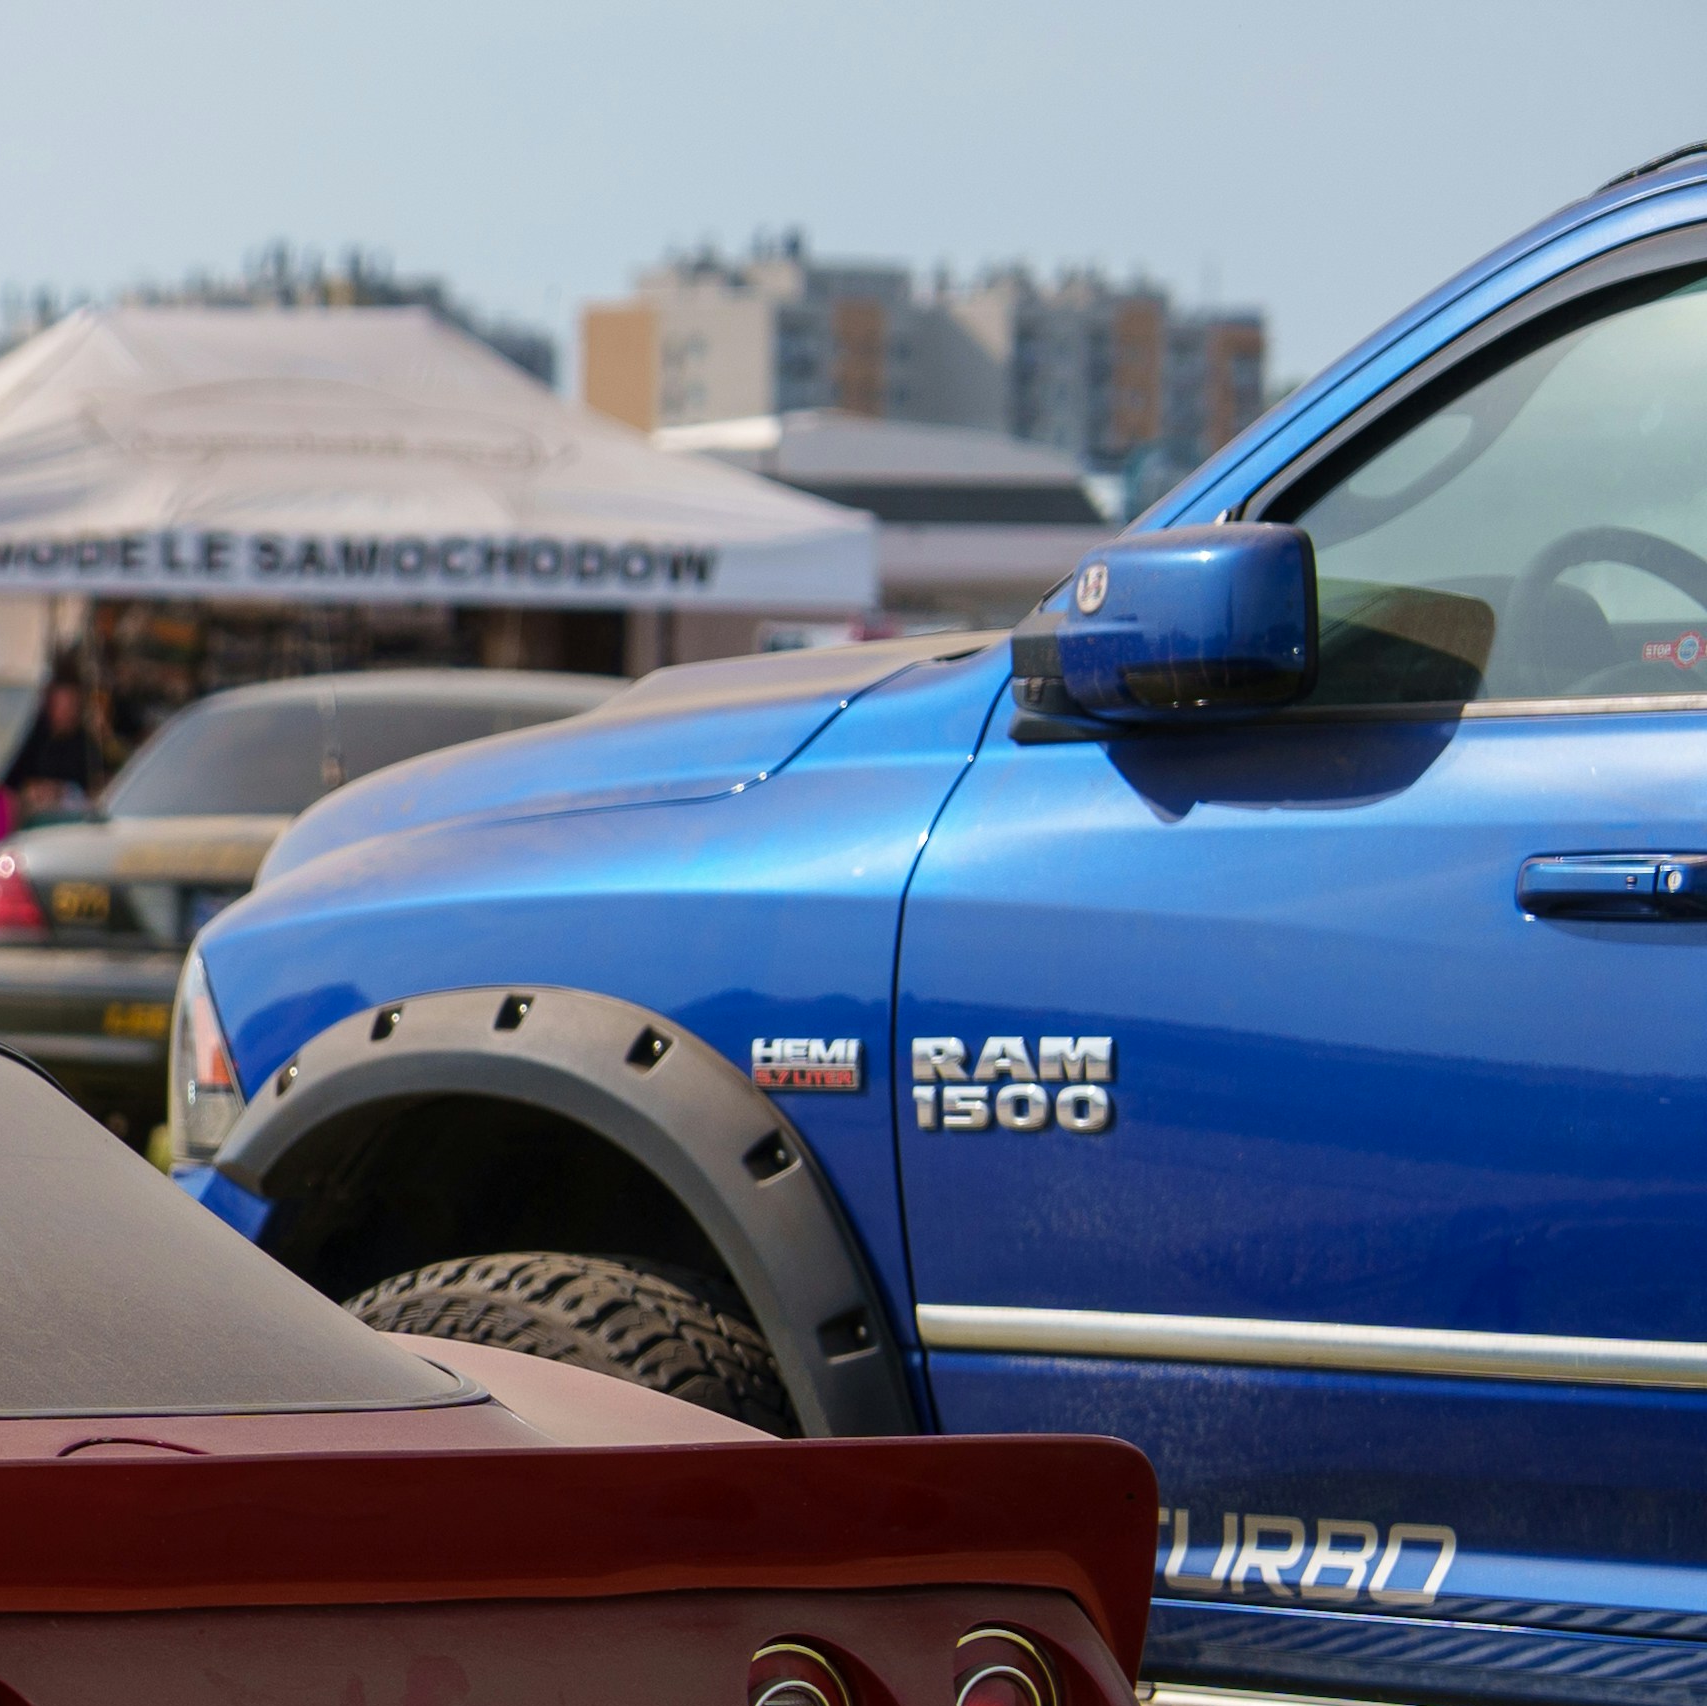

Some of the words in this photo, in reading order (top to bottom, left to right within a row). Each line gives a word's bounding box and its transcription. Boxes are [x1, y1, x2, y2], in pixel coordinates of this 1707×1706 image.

[752, 1037, 861, 1063] HEMI
[911, 1036, 1114, 1083] RAM
[792, 1070, 853, 1086] LITER
[912, 1083, 1113, 1133] 1500
[1158, 1507, 1456, 1608] URBO
